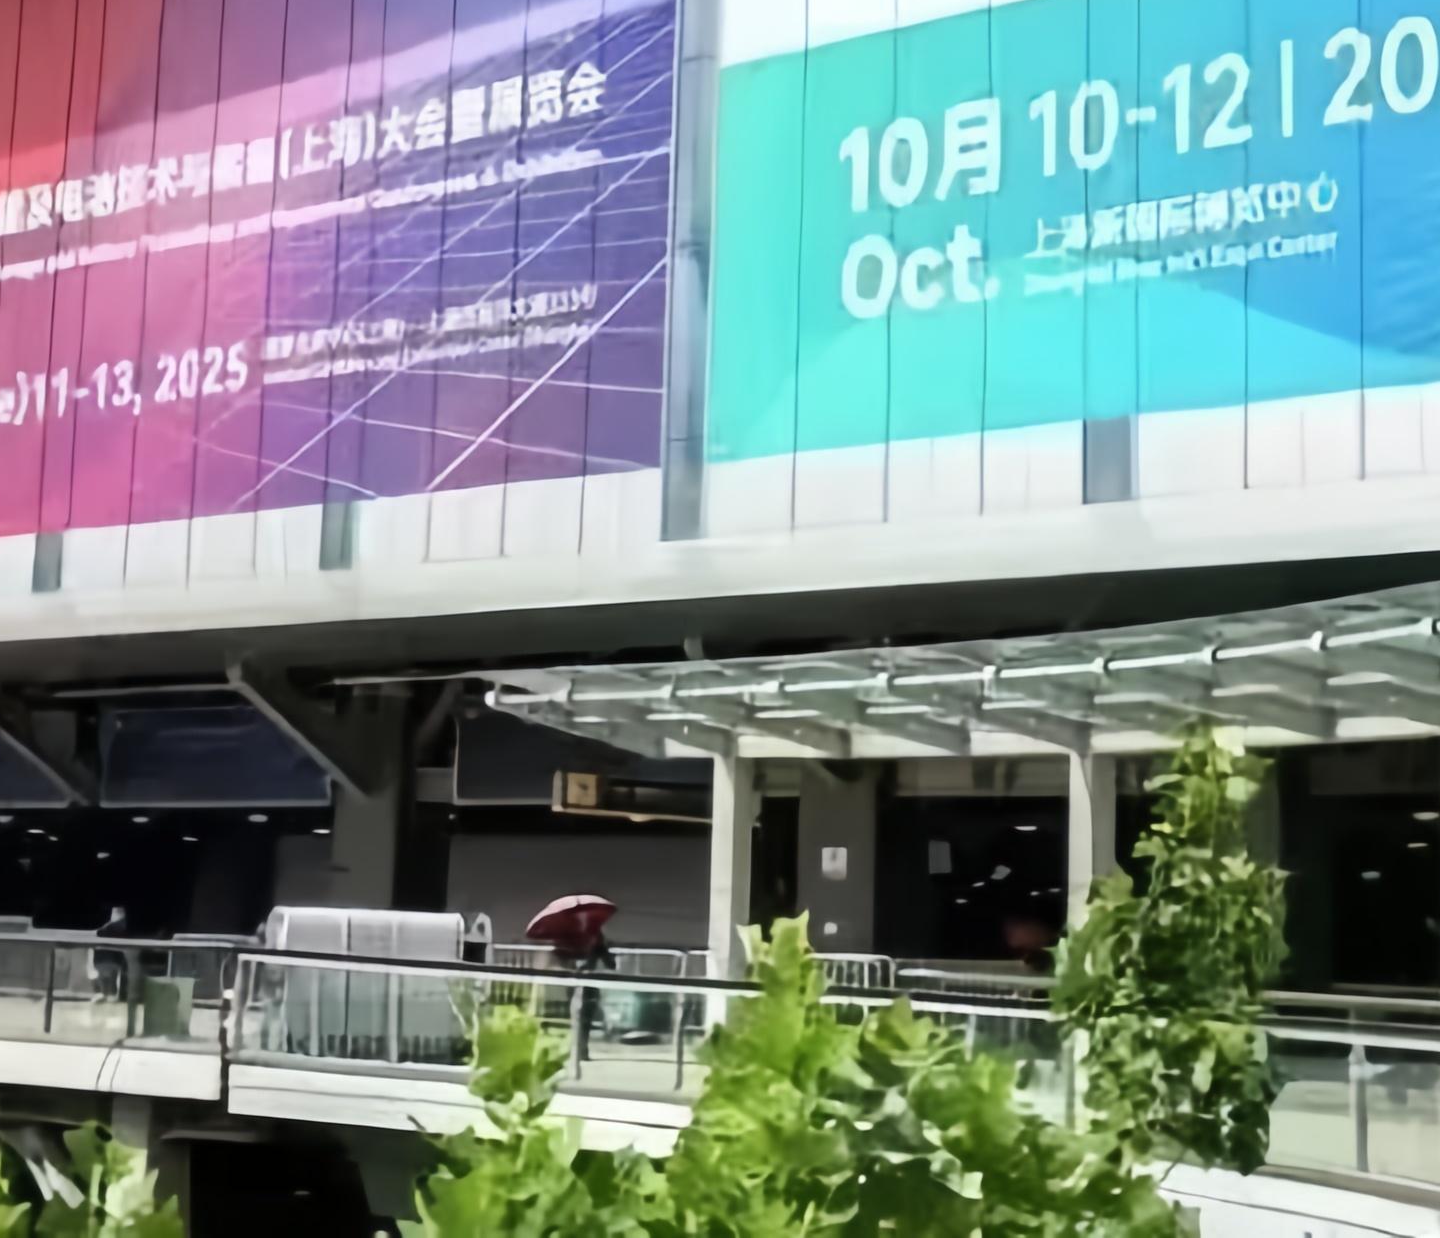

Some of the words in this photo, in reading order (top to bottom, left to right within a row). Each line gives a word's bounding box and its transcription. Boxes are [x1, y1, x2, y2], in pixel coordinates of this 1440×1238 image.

[838, 97, 1001, 213] 10月
[1029, 52, 1253, 177] 10-12
[838, 223, 1001, 319] Oct.
[154, 342, 249, 403] 2025
